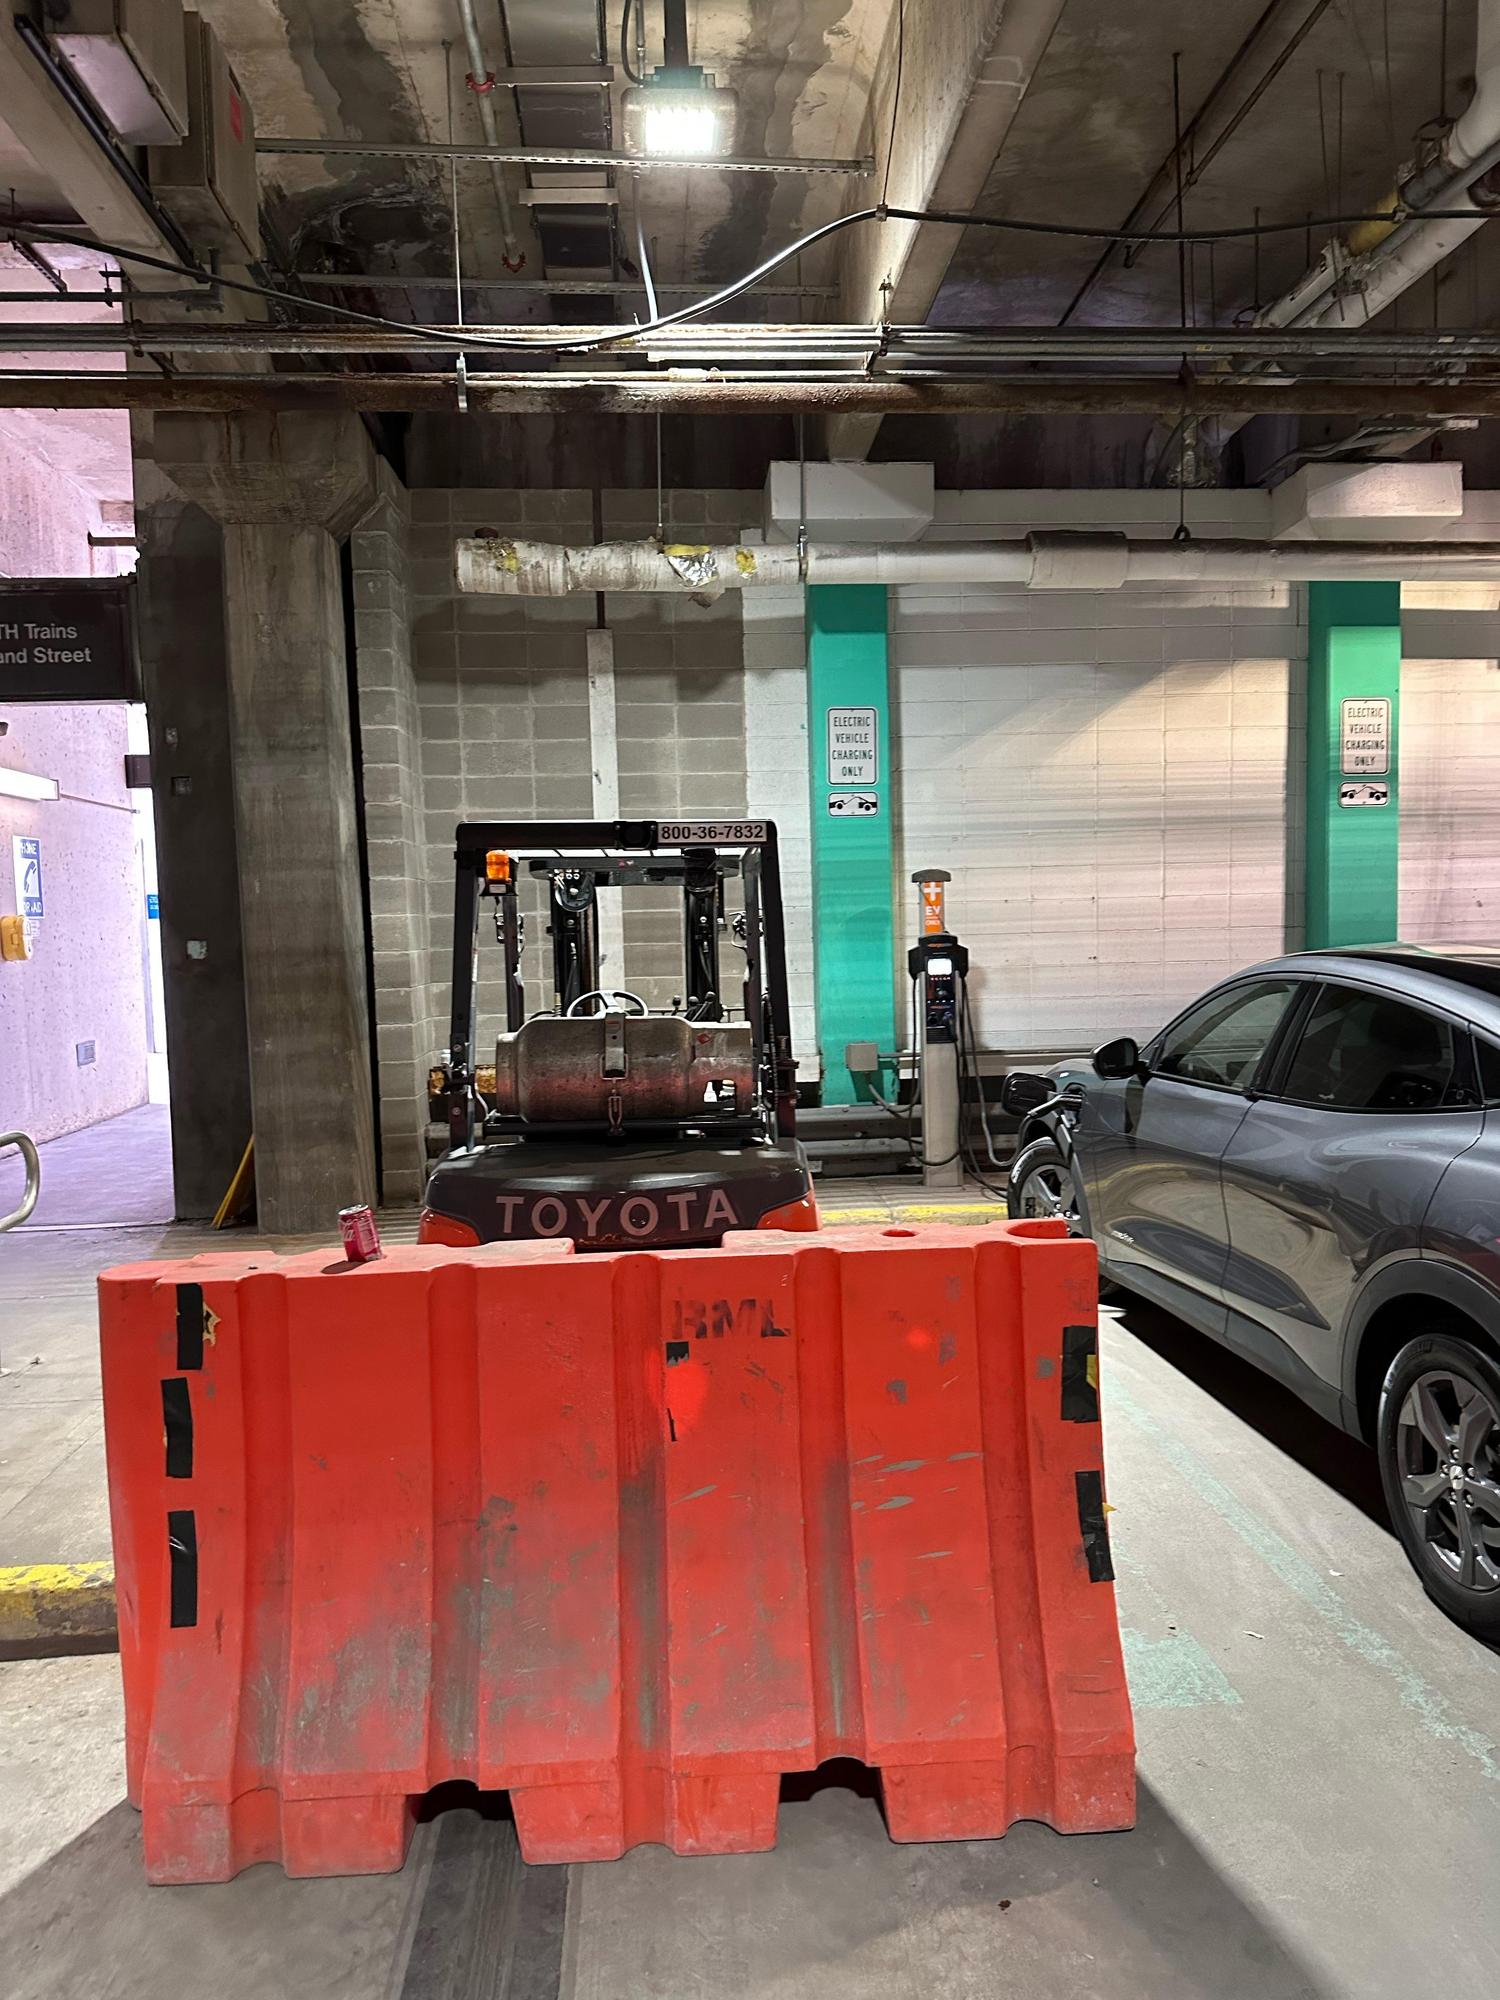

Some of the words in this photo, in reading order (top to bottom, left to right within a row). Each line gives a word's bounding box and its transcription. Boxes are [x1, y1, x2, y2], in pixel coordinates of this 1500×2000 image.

[24, 623, 78, 640] Trains
[33, 646, 92, 664] Street
[1347, 707, 1384, 718] ELECTRIC
[833, 716, 871, 727] ELECTRIC
[1349, 723, 1382, 734] VEHICLE
[835, 733, 869, 743] VEHICLE
[1345, 740, 1385, 750] CHARGING
[832, 750, 873, 760] CHARGING
[1354, 756, 1376, 766] ONLY
[842, 766, 864, 776] ONLY
[662, 825, 763, 839] 800-36-7832
[925, 905, 941, 916] EV
[496, 1189, 739, 1237] TOYOTA
